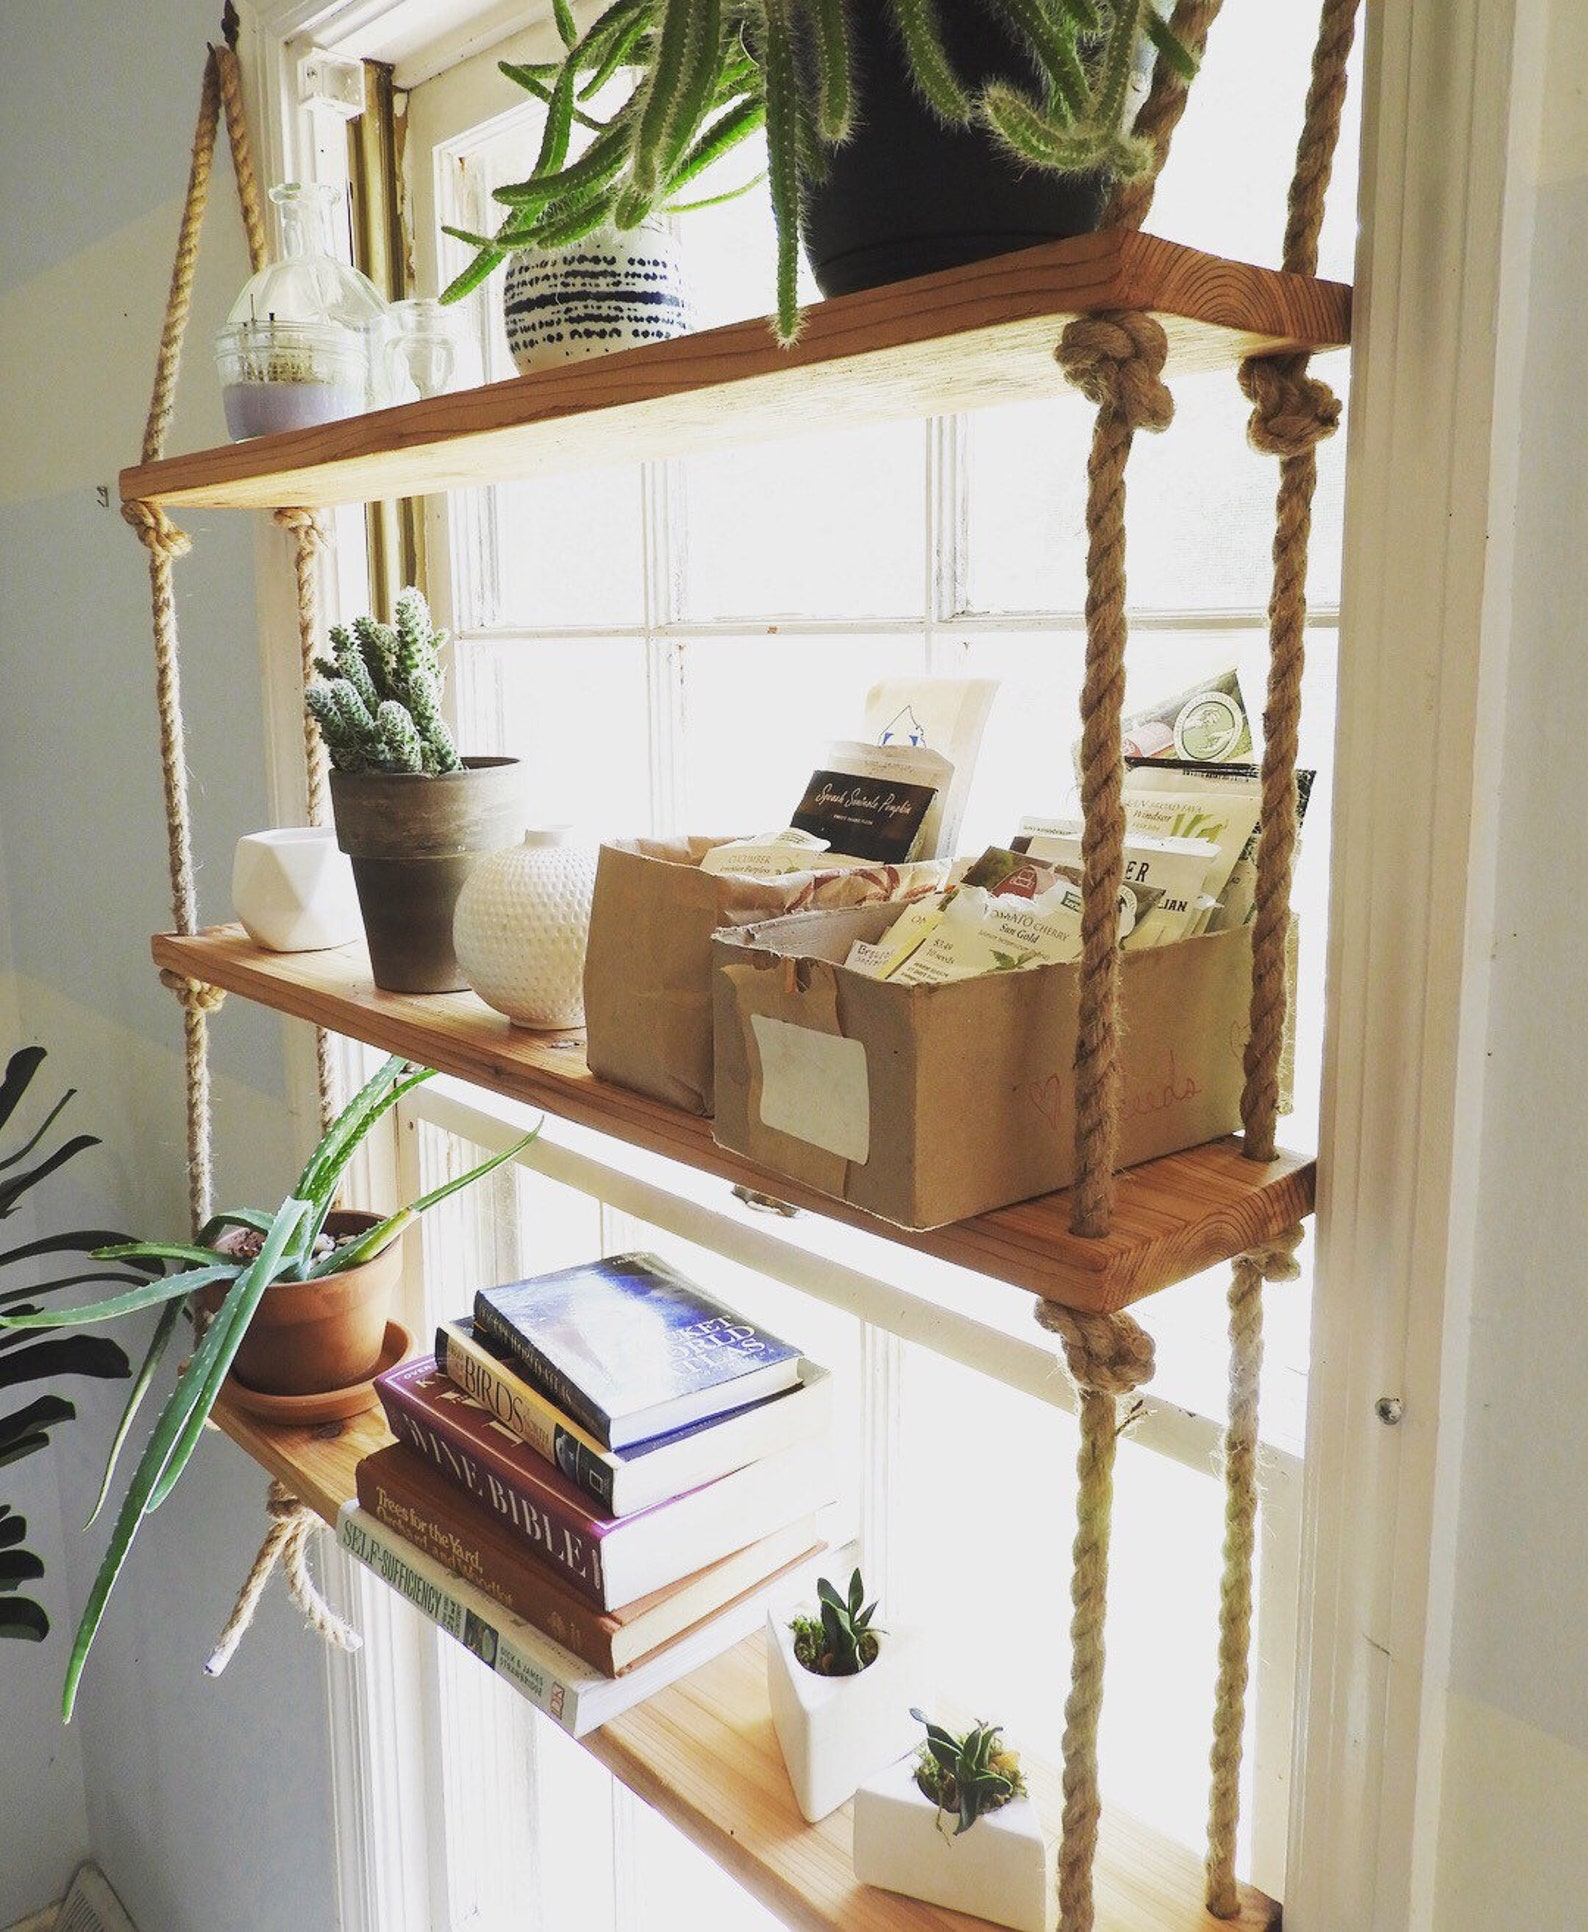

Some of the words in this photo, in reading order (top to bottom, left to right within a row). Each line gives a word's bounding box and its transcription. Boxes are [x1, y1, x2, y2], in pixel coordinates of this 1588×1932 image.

[1016, 928, 1040, 945] Gold
[1033, 921, 1070, 942] CHERRY
[403, 1364, 434, 1381] OVER
[464, 1356, 524, 1433] BIRDS
[402, 1412, 484, 1497] WINE
[487, 1473, 587, 1579] BIBLE
[376, 1486, 410, 1520] Trees
[409, 1508, 428, 1532] for
[429, 1522, 450, 1549] the
